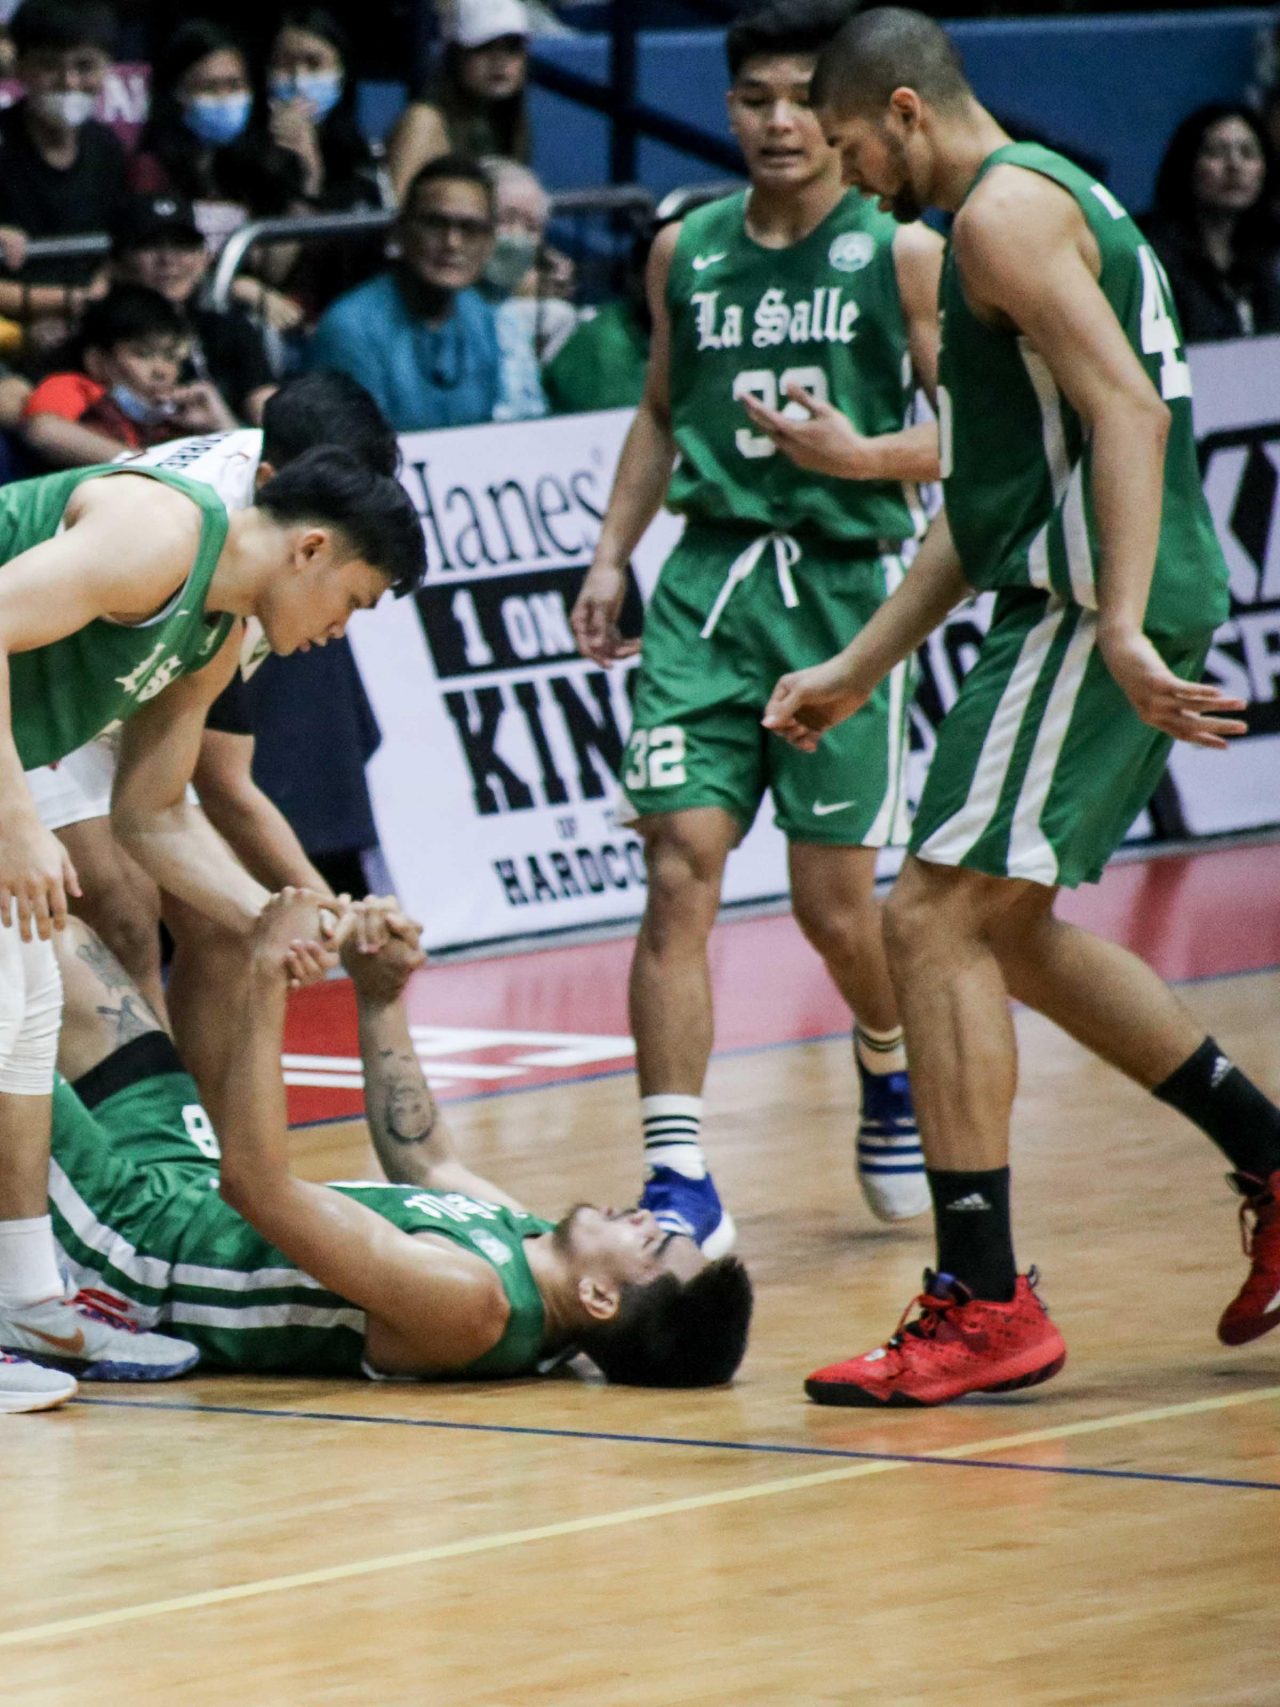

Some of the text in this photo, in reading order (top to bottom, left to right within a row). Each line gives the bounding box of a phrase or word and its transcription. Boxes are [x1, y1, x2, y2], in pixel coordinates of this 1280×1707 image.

[691, 287, 860, 350] La Salle
[443, 668, 634, 815] KIN
[625, 725, 687, 790] 32
